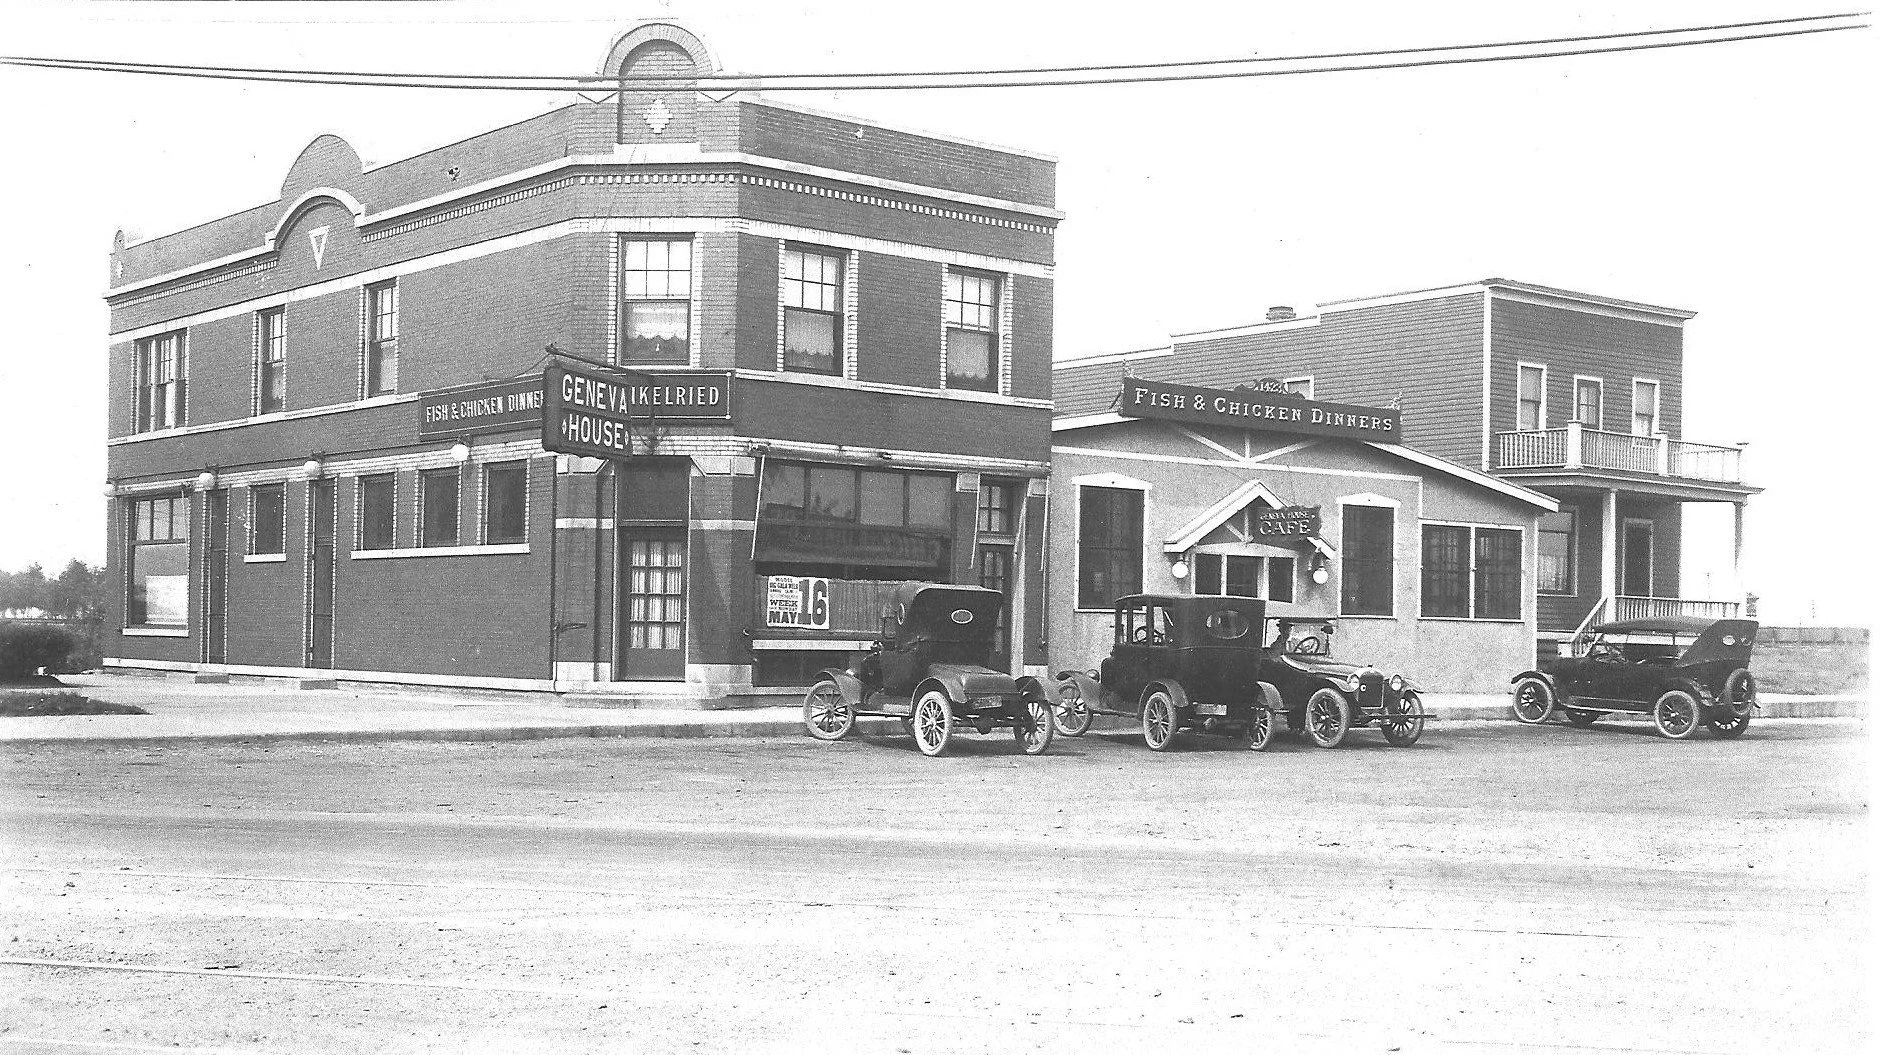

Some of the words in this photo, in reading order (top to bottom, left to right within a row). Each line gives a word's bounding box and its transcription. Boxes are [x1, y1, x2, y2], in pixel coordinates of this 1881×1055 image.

[562, 373, 628, 414] GENEVA
[426, 404, 449, 423] FISH
[451, 402, 460, 420] &
[460, 396, 504, 418] CHICKEN
[1135, 387, 1186, 409] FISH
[1193, 394, 1206, 411] &
[1214, 397, 1302, 421] CHICKEN
[1311, 408, 1393, 431] DINNERS
[568, 416, 624, 449] HOUSE
[1260, 519, 1311, 535] CAFE
[770, 599, 798, 607] WEEK
[798, 579, 827, 625] 16
[768, 611, 798, 624] MAY
